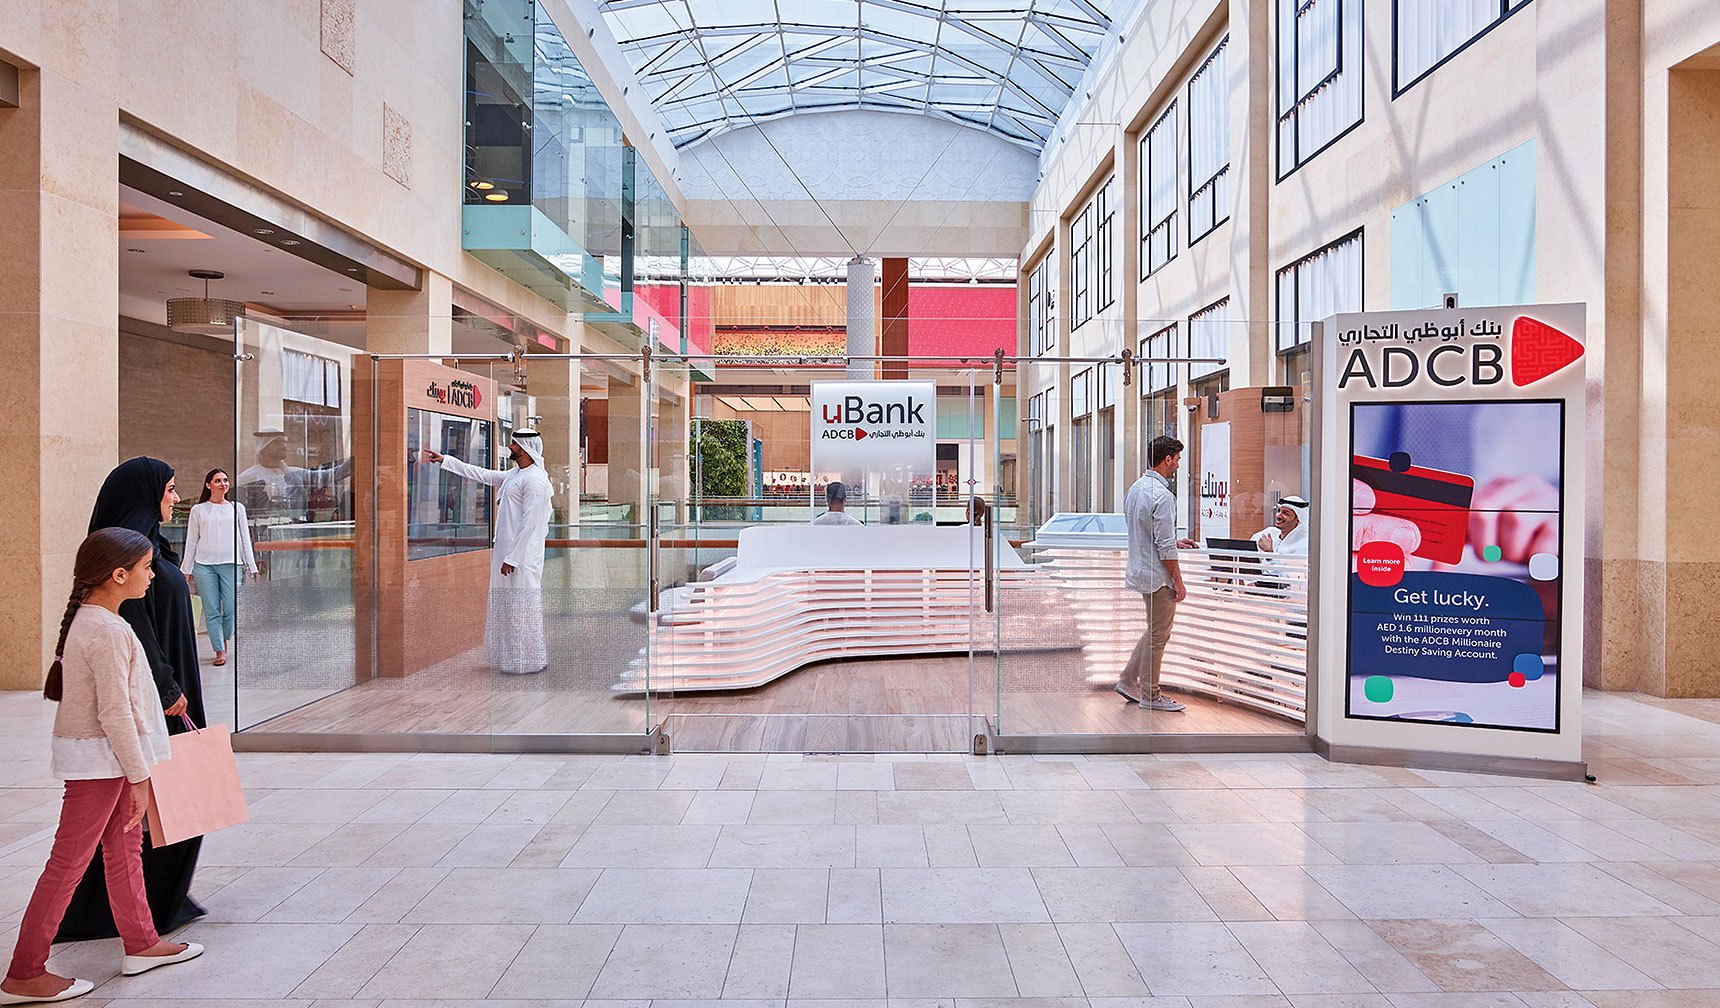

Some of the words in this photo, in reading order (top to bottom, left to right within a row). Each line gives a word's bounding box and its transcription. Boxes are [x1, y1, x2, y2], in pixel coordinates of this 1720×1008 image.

[1338, 324, 1399, 346] التجاري
[1403, 319, 1465, 344] أبوظبي
[1470, 320, 1502, 339] بنك
[1338, 344, 1504, 389] ADCB
[451, 388, 473, 409] ADCB
[823, 396, 925, 424] uBank
[822, 429, 855, 439] ADCB
[1394, 588, 1428, 605] Get
[1434, 589, 1490, 610] lucky.
[1393, 612, 1412, 622] Win
[1413, 614, 1429, 623] 111
[1430, 614, 1459, 625] prizes
[1461, 617, 1490, 625] worth
[1376, 623, 1397, 632] AED
[1398, 624, 1413, 633] 1.6
[1414, 625, 1472, 637] millionevery
[1474, 628, 1507, 637] month
[1381, 634, 1402, 643] with
[1404, 635, 1420, 644] the
[1421, 636, 1450, 646] ADCB
[1452, 637, 1502, 649] Millionaire
[1385, 645, 1420, 656] Destiny
[1421, 647, 1453, 659] Saving
[1454, 649, 1498, 660] Account.
